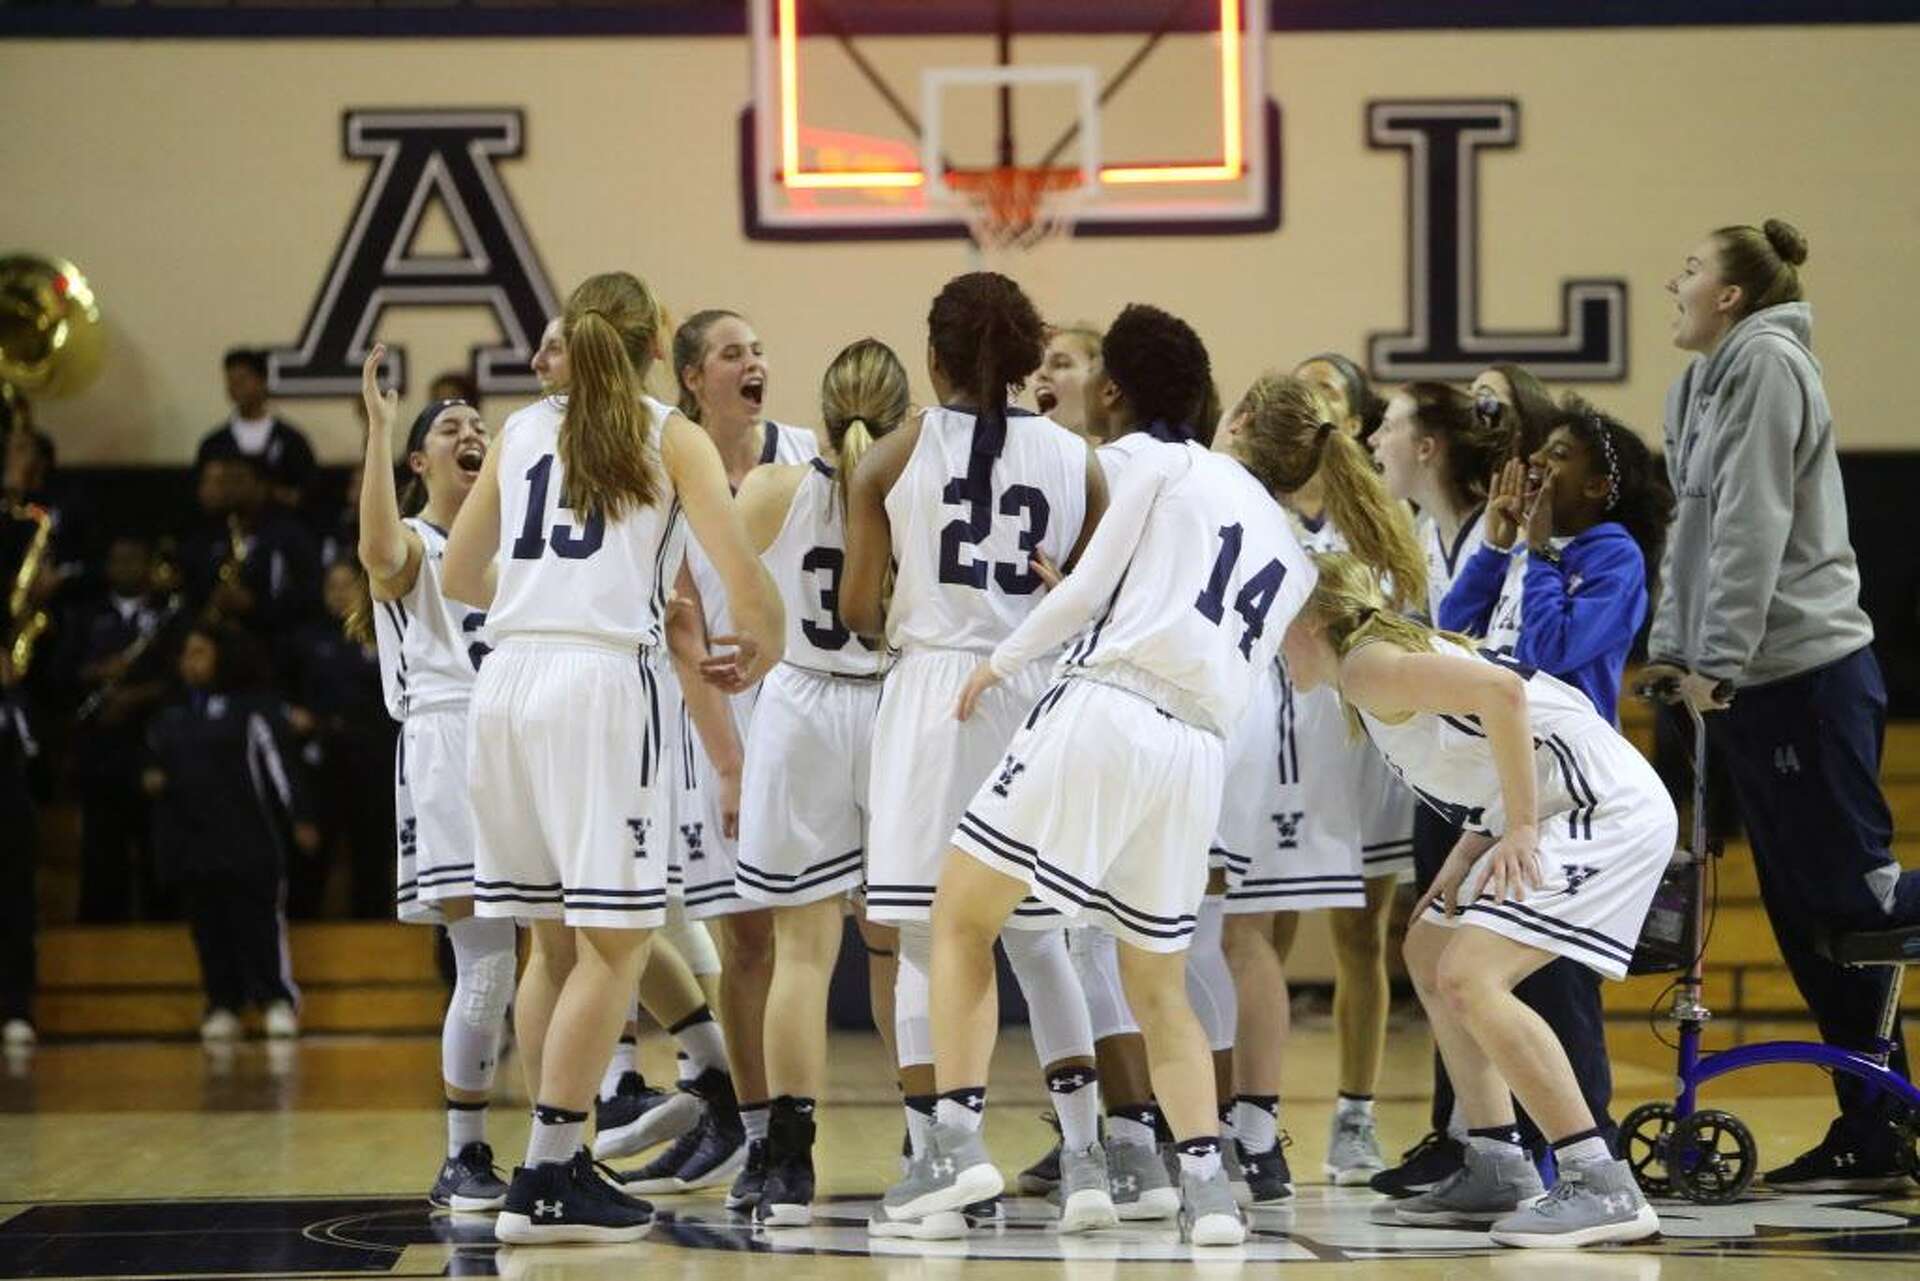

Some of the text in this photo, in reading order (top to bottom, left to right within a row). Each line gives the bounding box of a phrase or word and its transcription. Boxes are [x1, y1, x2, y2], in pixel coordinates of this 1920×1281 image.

[268, 98, 1630, 398] A L
[801, 546, 880, 652] 3
[938, 475, 1050, 596] 23
[1194, 521, 1288, 663] 14
